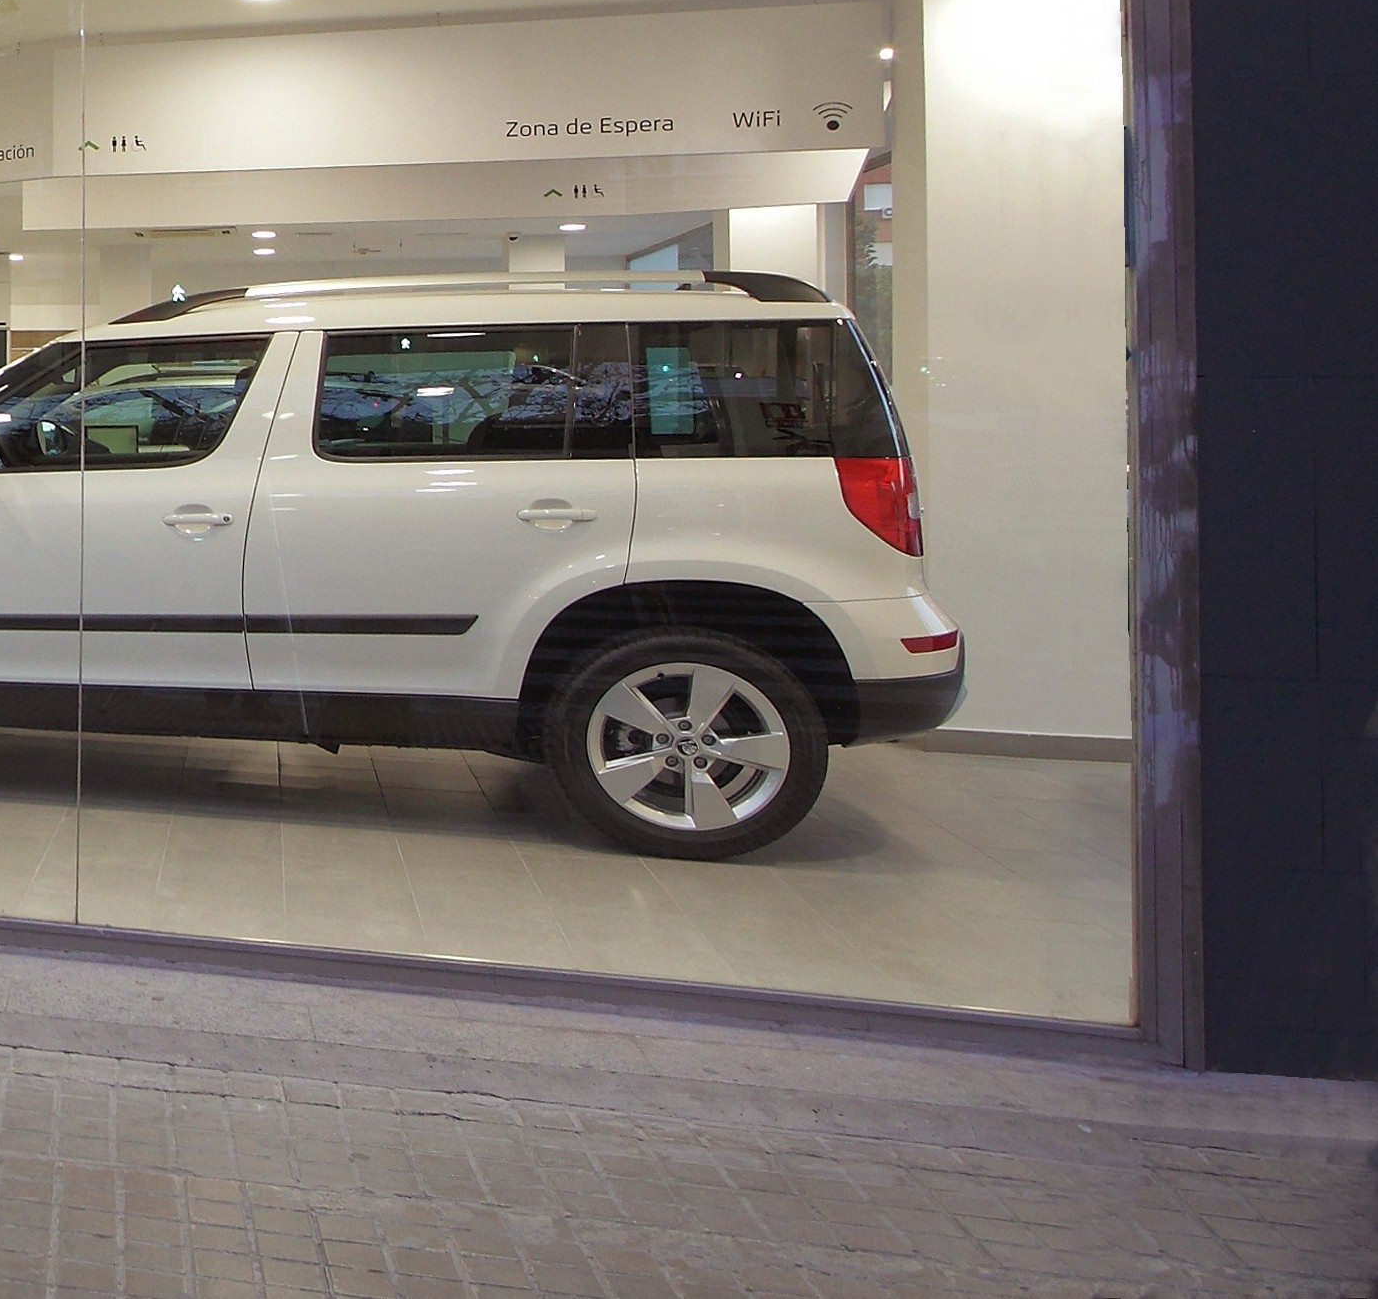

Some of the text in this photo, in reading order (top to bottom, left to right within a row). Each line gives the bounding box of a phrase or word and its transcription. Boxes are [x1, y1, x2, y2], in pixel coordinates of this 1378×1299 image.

[505, 116, 675, 138] Zona de Espera
[732, 109, 782, 129] WiFi
